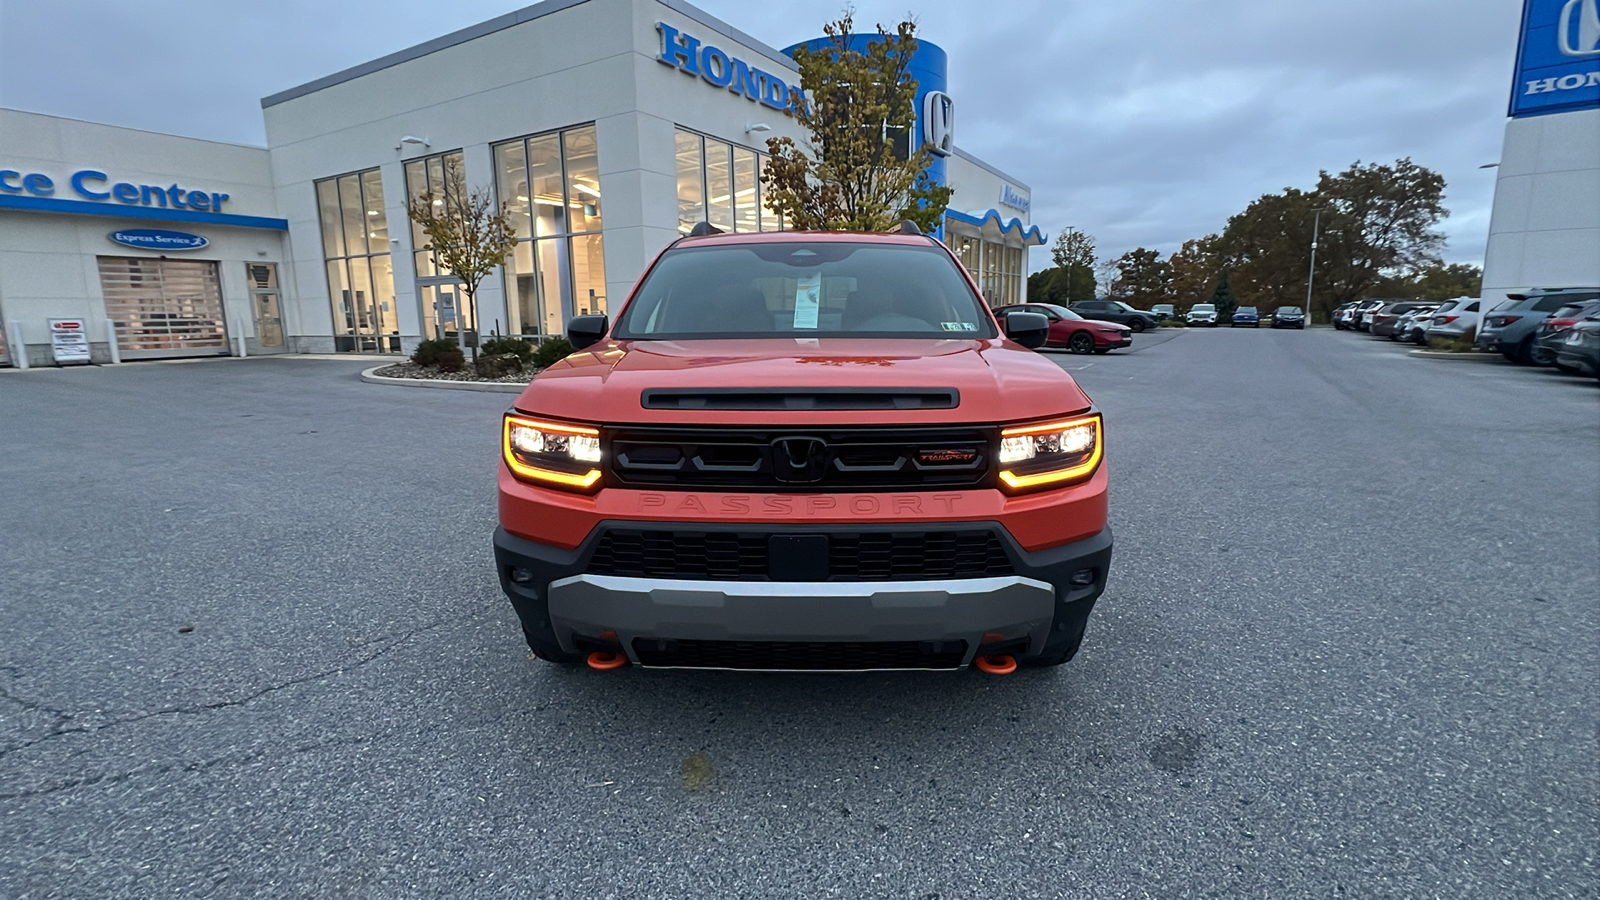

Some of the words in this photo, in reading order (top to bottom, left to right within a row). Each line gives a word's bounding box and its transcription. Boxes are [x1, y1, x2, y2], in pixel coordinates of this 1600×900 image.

[70, 170, 230, 212] Center
[115, 232, 154, 243] Express
[155, 235, 190, 244] Service
[636, 493, 963, 515] PASSPORT
